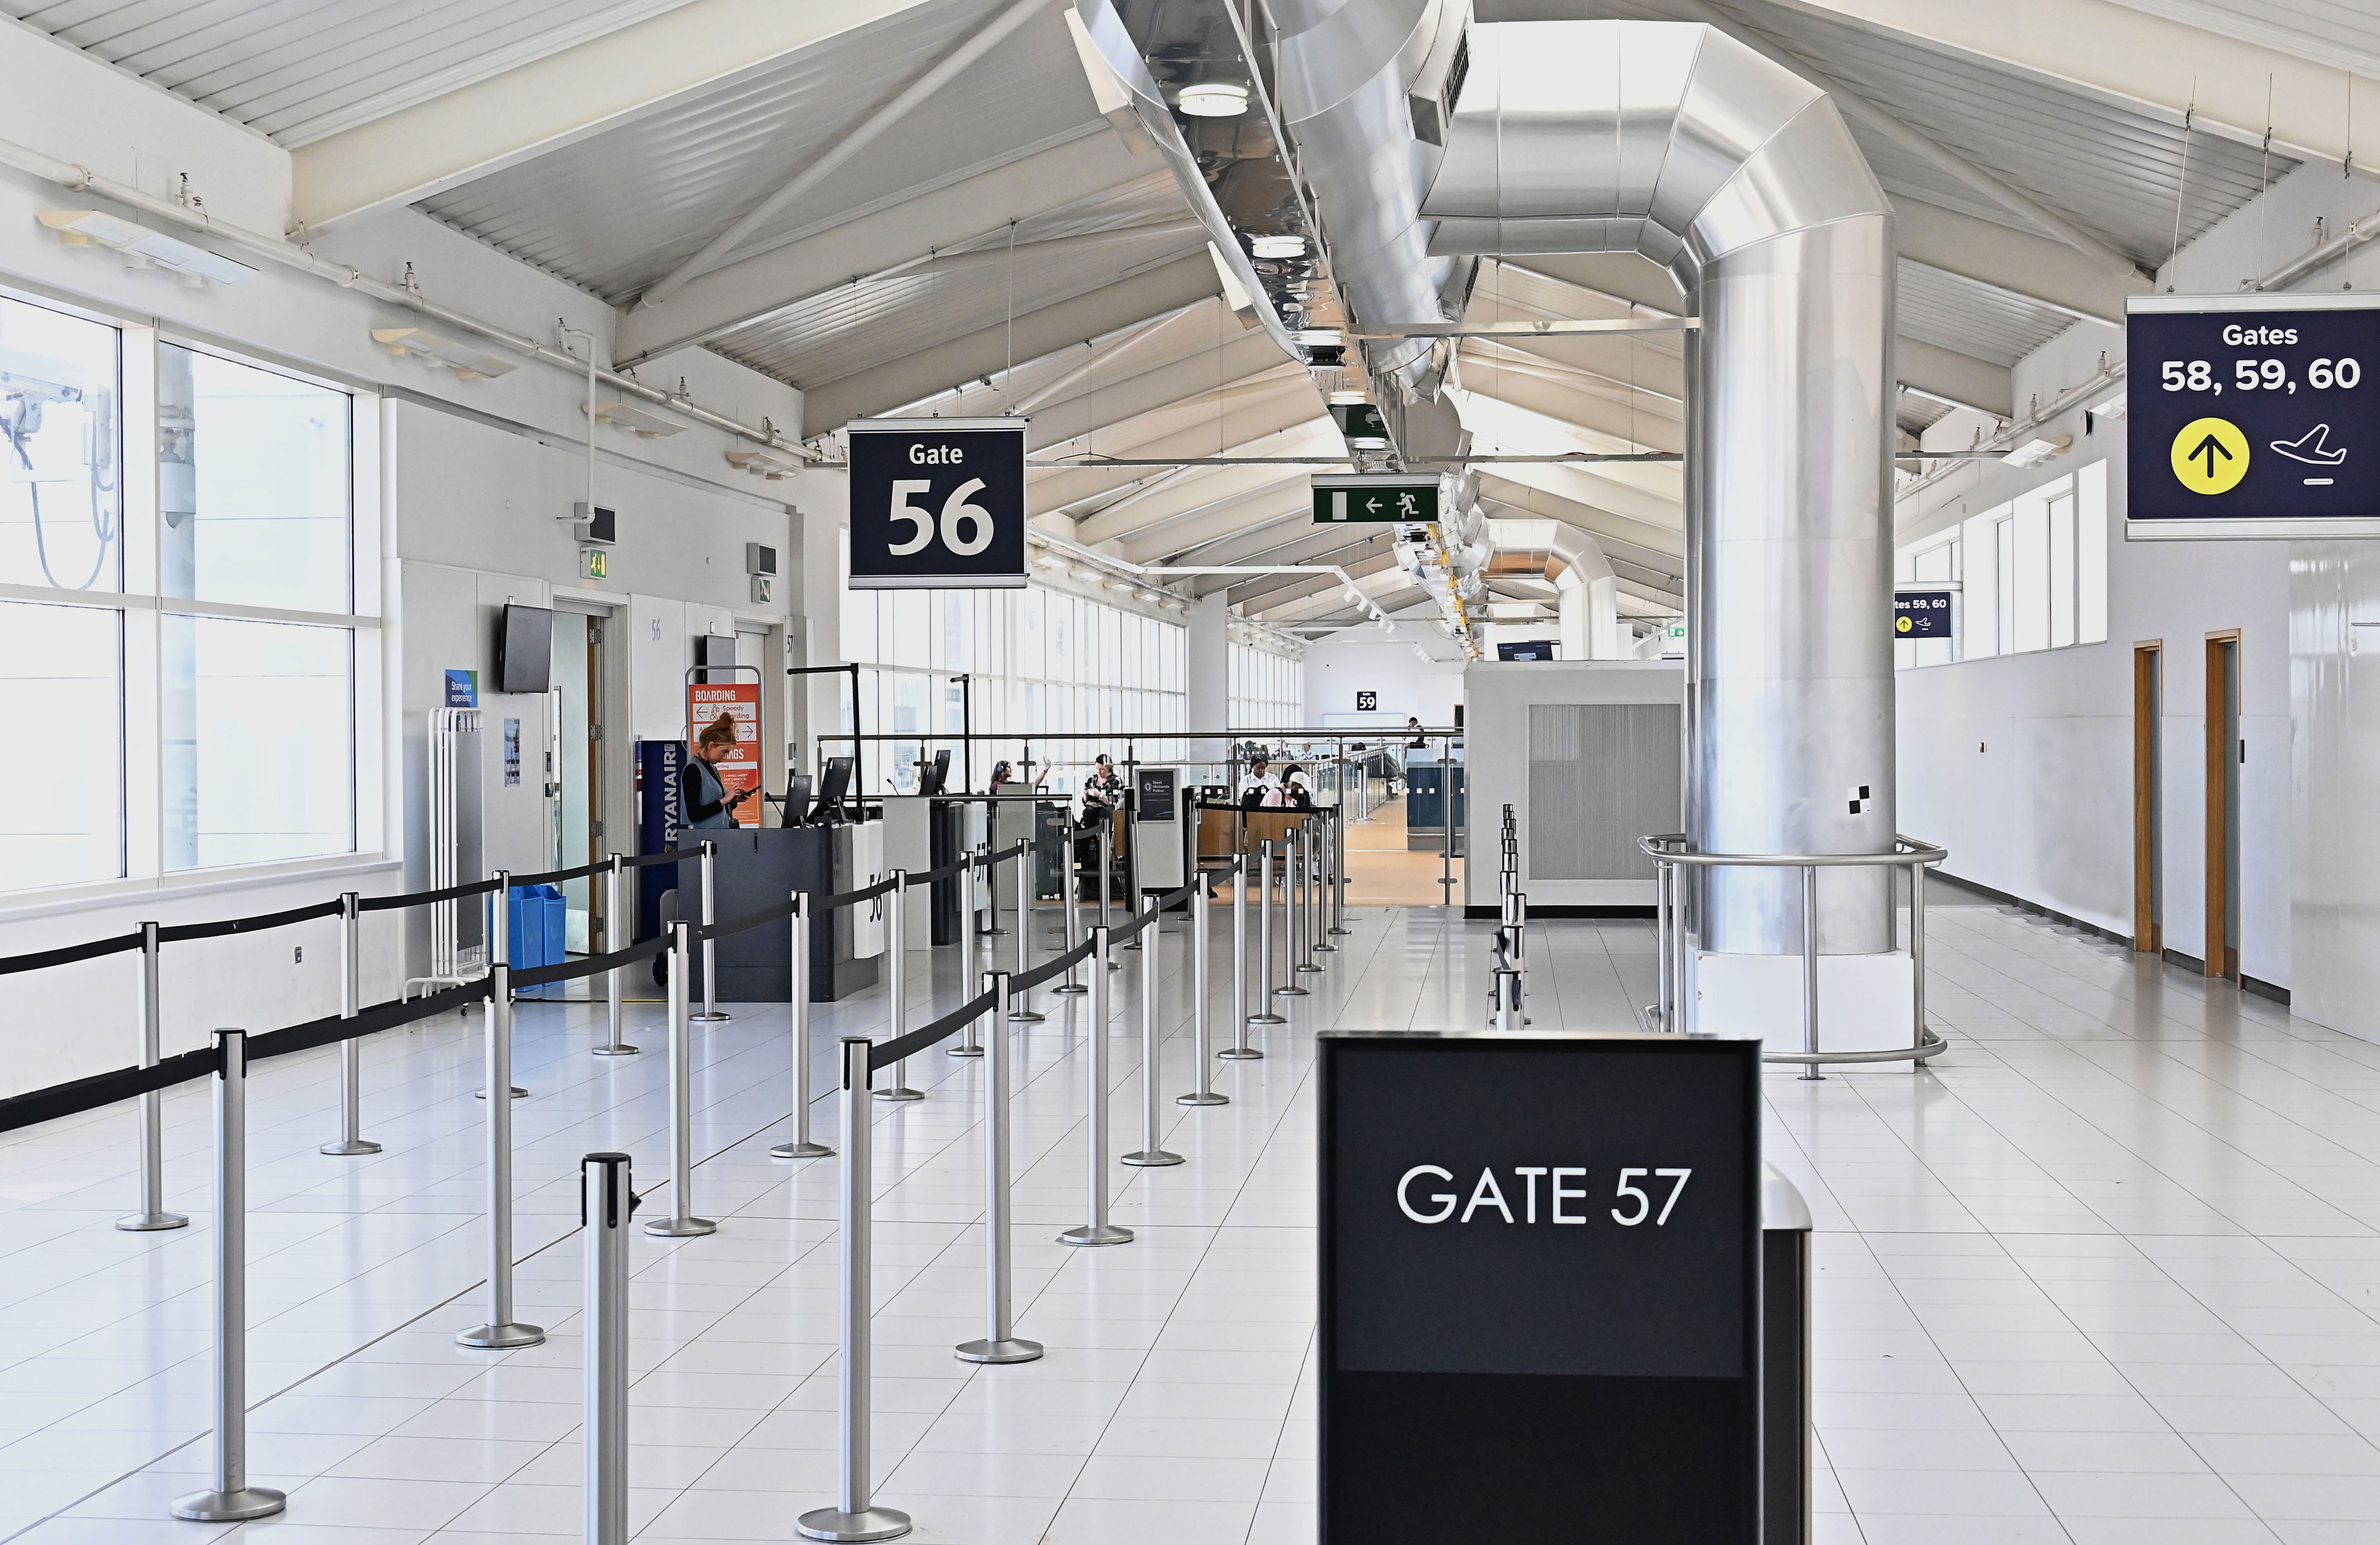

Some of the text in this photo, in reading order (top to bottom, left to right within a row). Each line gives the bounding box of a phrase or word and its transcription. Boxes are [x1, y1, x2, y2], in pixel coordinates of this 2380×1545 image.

[2223, 324, 2298, 346] Gates
[2162, 357, 2360, 396] 58, 59, 60
[909, 444, 963, 465] Gate
[888, 477, 994, 556] 56
[1894, 599, 1947, 610] tes 59, 60
[652, 618, 660, 642] 56
[787, 635, 793, 653] 57
[452, 681, 472, 693] Share your
[695, 690, 736, 701] BOARDING
[452, 693, 472, 704] experience
[1359, 696, 1376, 709] 59
[727, 748, 744, 759] AGS
[664, 751, 677, 841] RYANAIR
[870, 871, 882, 922] 56
[1397, 1164, 1692, 1226] GATE 57
